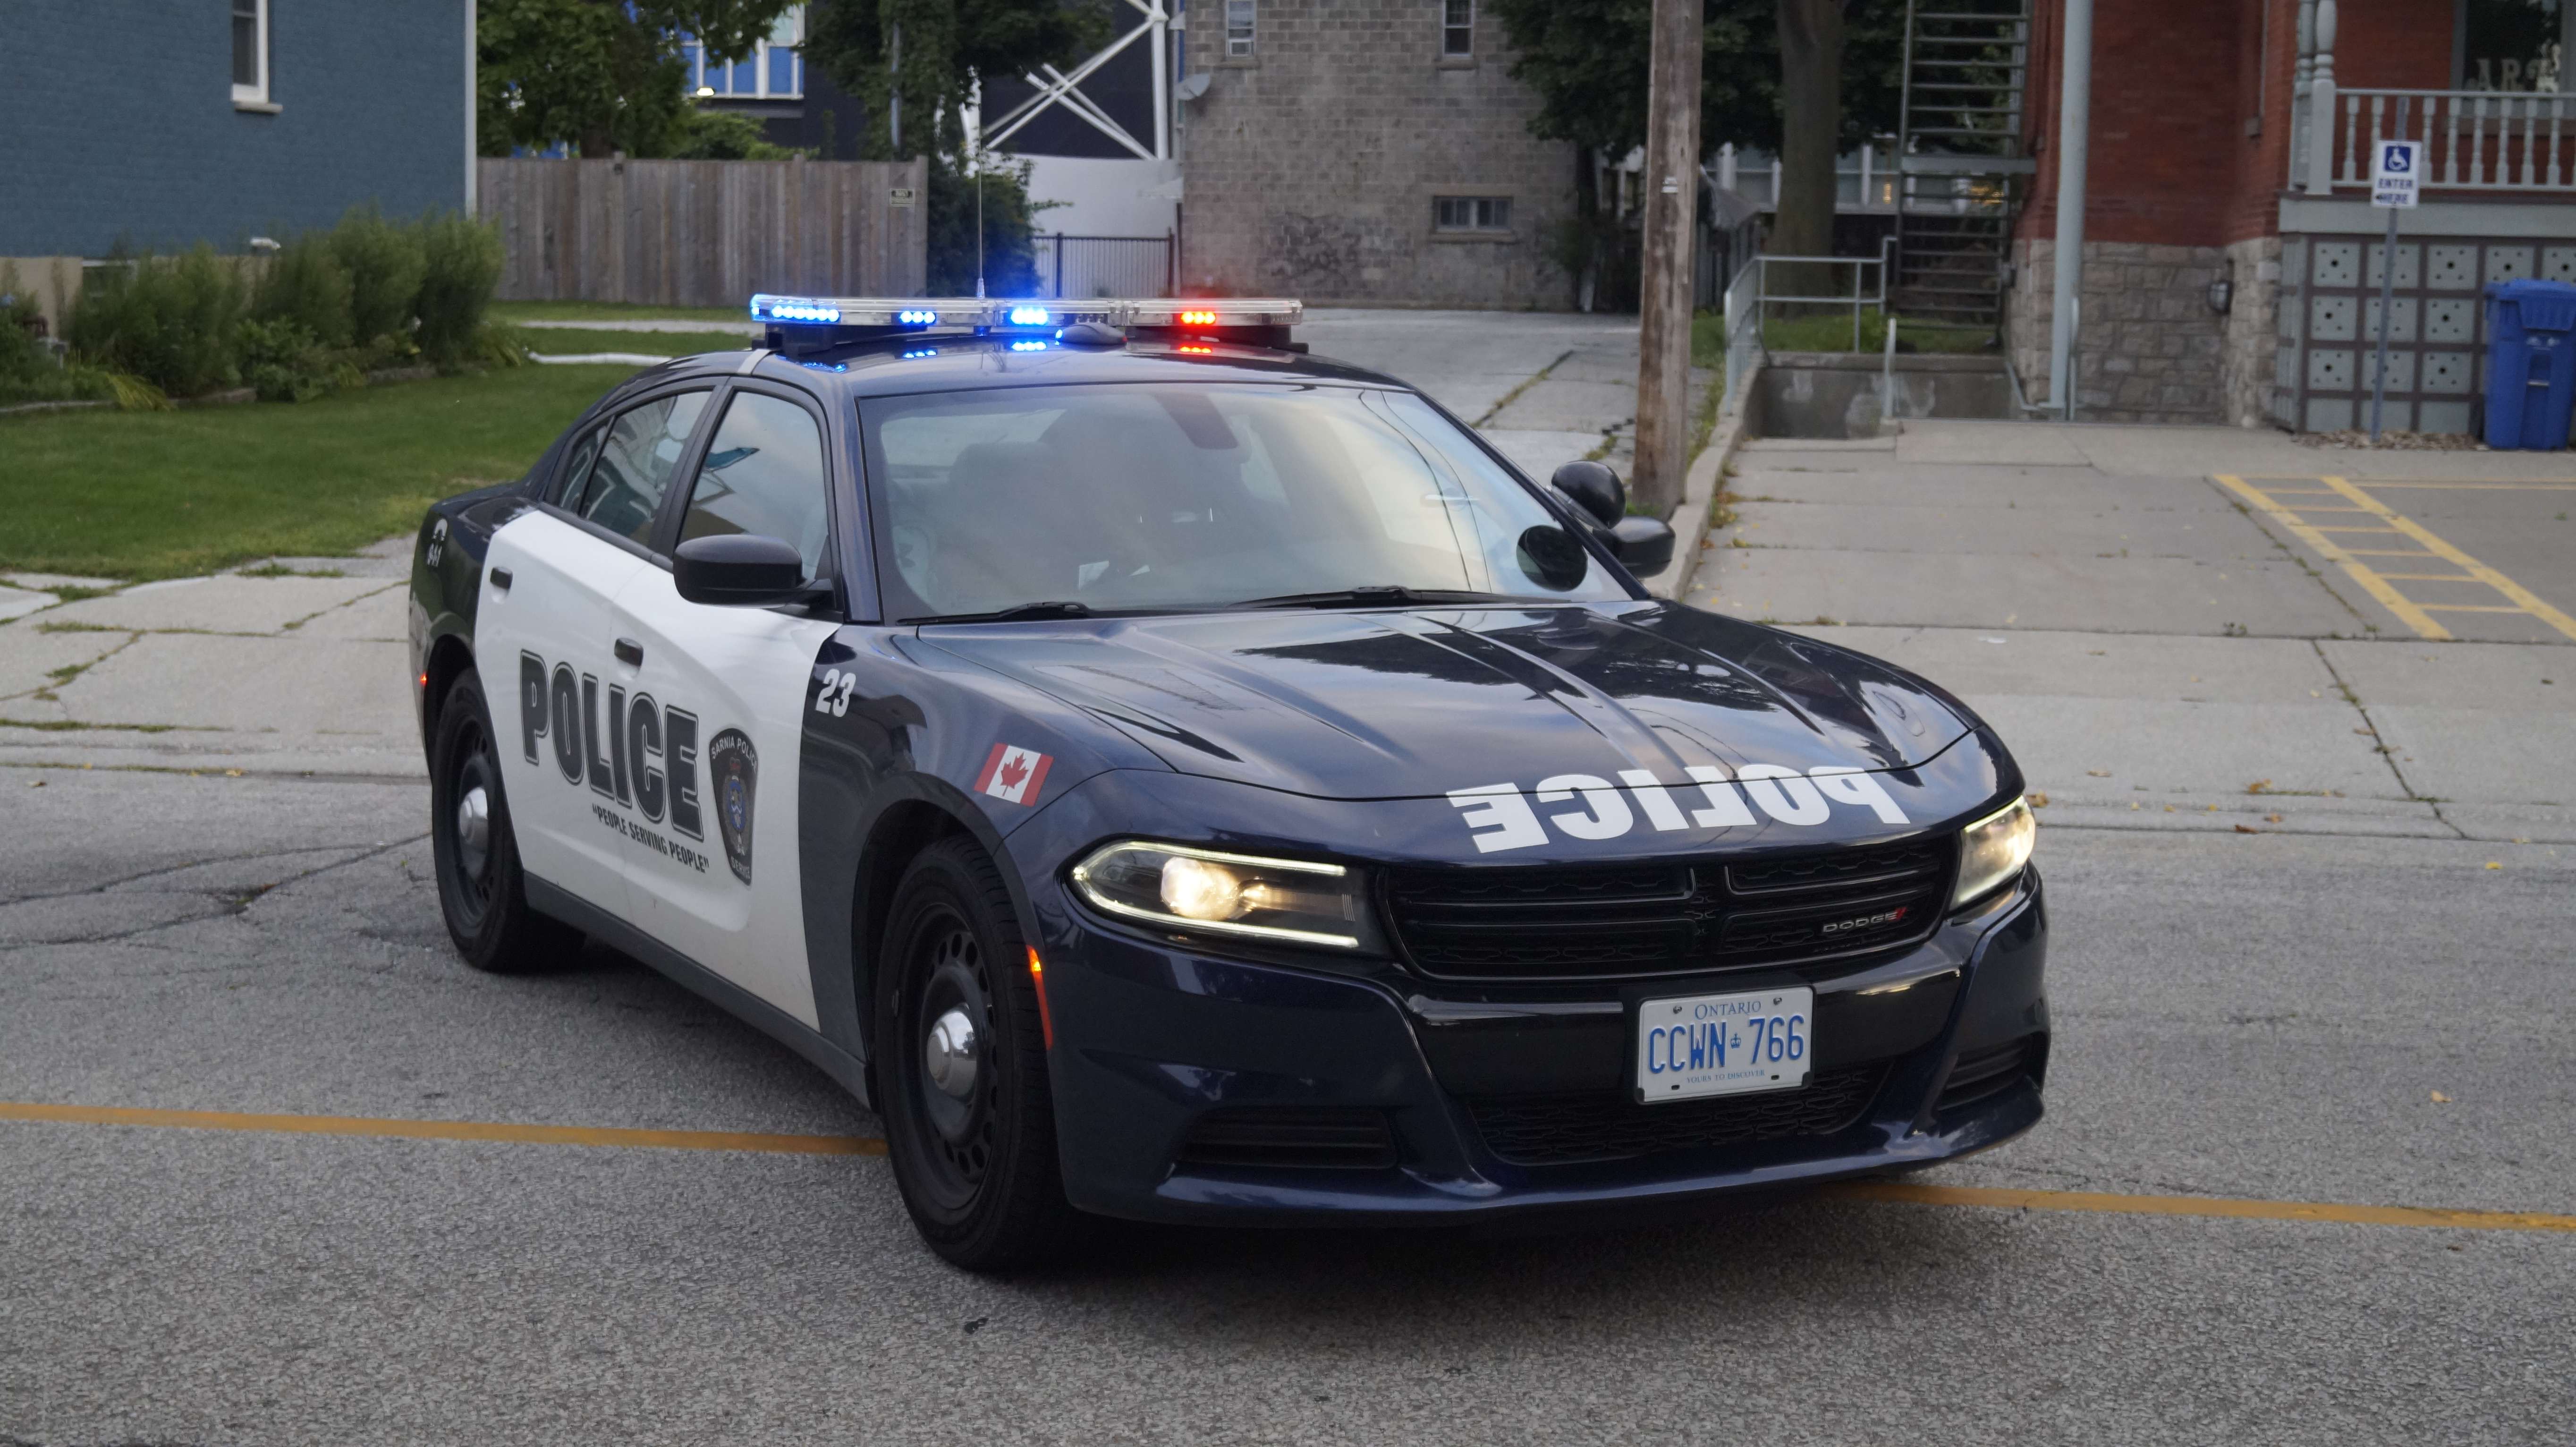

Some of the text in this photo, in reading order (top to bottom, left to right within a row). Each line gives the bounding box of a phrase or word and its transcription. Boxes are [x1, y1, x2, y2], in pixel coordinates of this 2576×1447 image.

[2379, 178, 2413, 189] ENTER
[816, 669, 856, 717] 23
[520, 648, 704, 843] POLICE
[712, 735, 735, 759] SARNIA
[628, 821, 669, 856] SERVING
[1823, 911, 1898, 933] DODGE
[1649, 1015, 1805, 1074] CCWN 766
[1686, 1075, 1712, 1084] YOURS
[1728, 1069, 1765, 1080] DISCOVER
